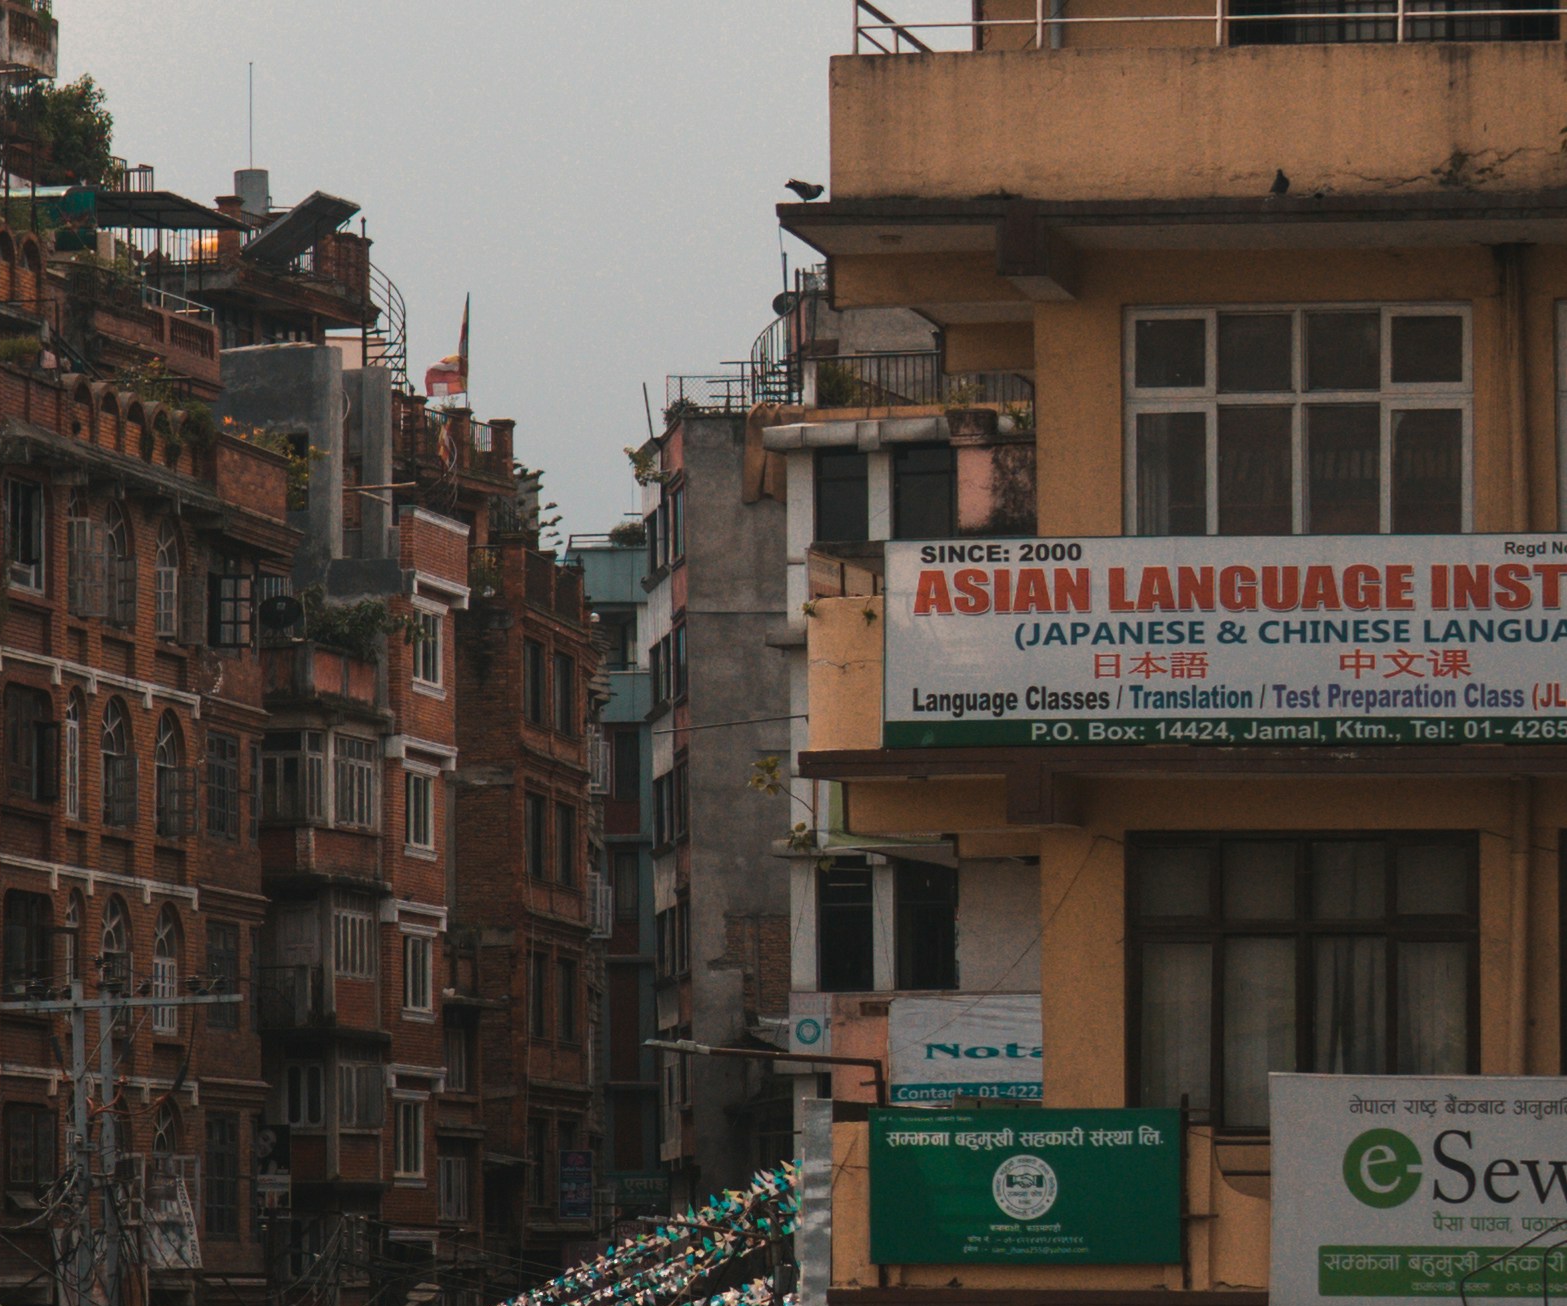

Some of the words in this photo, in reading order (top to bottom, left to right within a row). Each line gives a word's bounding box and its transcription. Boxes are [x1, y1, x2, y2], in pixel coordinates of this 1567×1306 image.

[920, 545, 1009, 563] SINCE:
[1019, 543, 1082, 561] 2000
[1504, 541, 1546, 557] Regd
[913, 567, 1092, 615] ASIAN
[1108, 564, 1415, 613] LANGUAGE
[1015, 621, 1205, 650] (JAPANESE
[1217, 620, 1247, 644] &
[1258, 620, 1411, 644] CHINESE
[1094, 651, 1208, 679] 日本語
[1339, 649, 1472, 679] 中文课
[912, 687, 1018, 717] Language
[1026, 685, 1110, 710] Classes
[1129, 684, 1252, 709] Translation
[1272, 684, 1320, 708] Test
[1328, 683, 1456, 713] Preparation
[1463, 683, 1524, 708] Class
[1031, 723, 1079, 740] P.O.
[1088, 721, 1145, 740] Box:
[1155, 721, 1235, 742] 14424,
[1243, 721, 1326, 742] Jamal,
[1410, 720, 1454, 739] Tel:
[1349, 1094, 1396, 1114] नेपाल
[954, 1127, 1014, 1150] बहुमुखी
[1019, 1126, 1084, 1148] सहकारी
[1089, 1126, 1134, 1148] संस्था
[1138, 1125, 1164, 1146] लि.
[1433, 1210, 1465, 1232] पैसा
[1407, 1251, 1480, 1278] बहुमुखी
